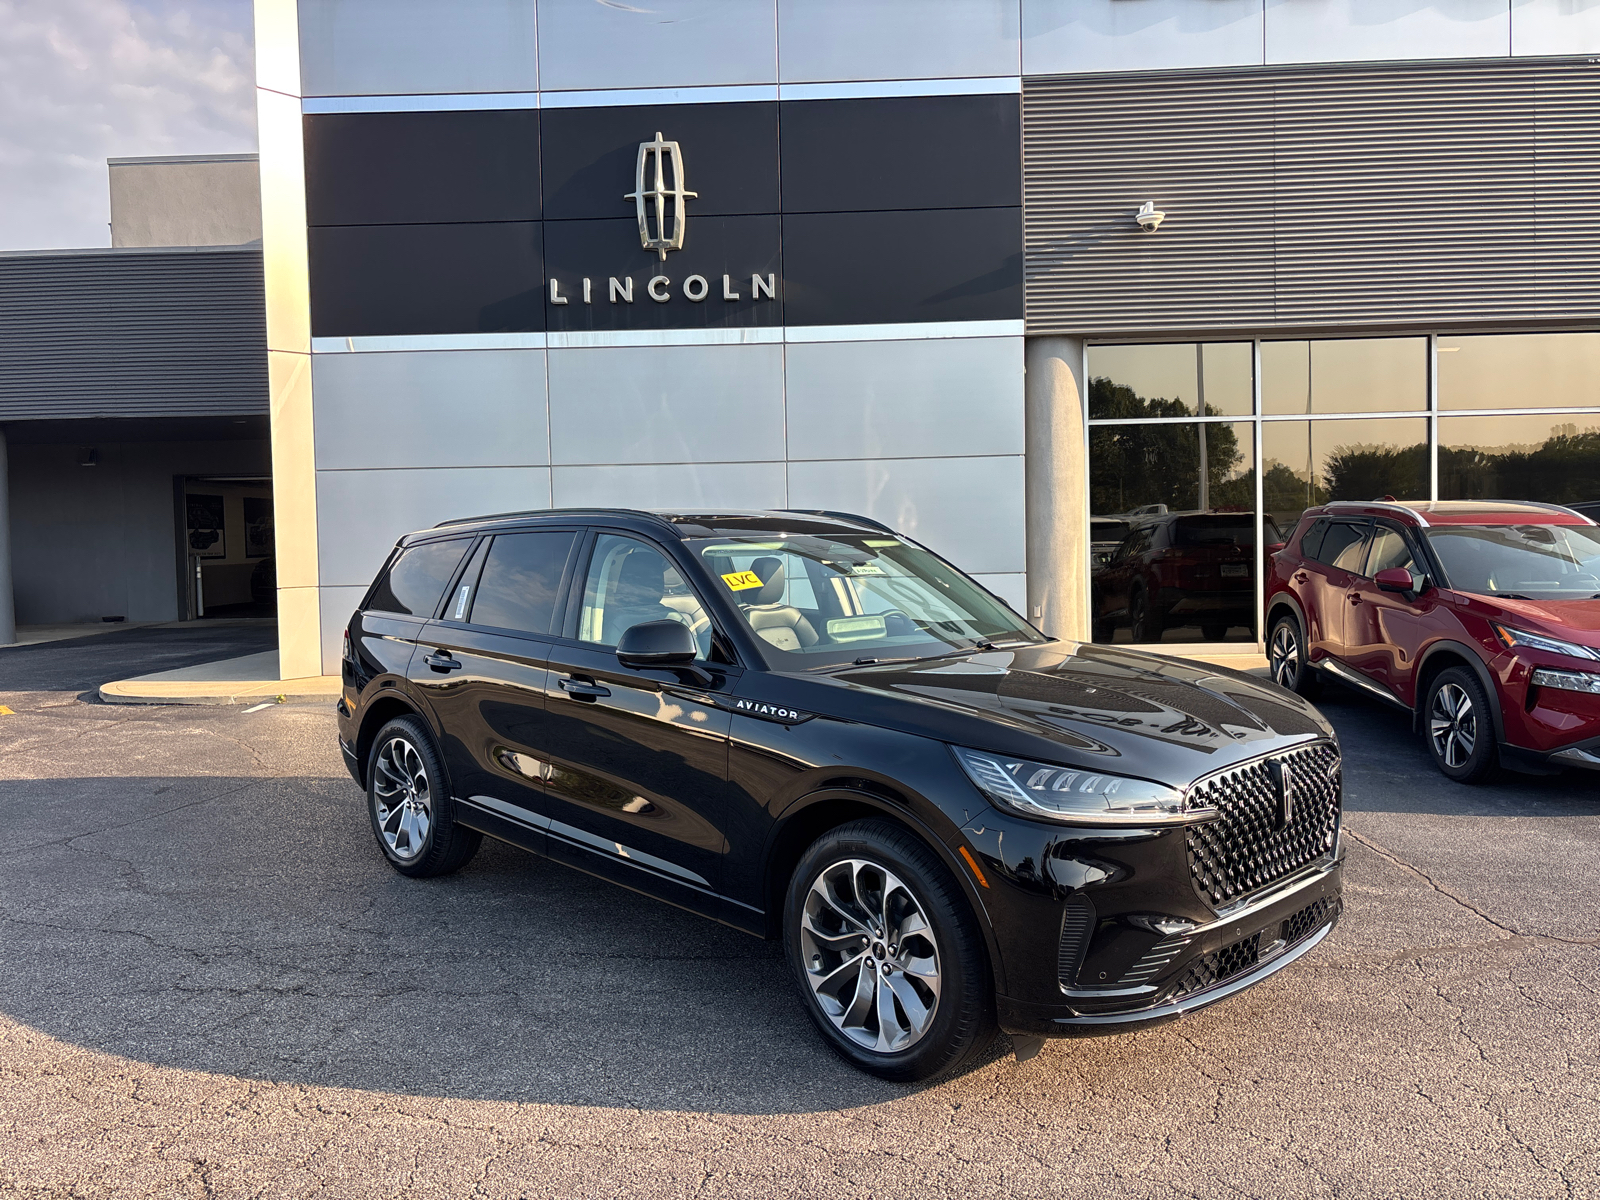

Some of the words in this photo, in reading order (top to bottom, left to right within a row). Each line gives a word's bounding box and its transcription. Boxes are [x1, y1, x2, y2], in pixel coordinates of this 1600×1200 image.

[550, 273, 775, 305] LINCOLN
[726, 573, 758, 587] LVC
[736, 700, 798, 719] AVIATOR
